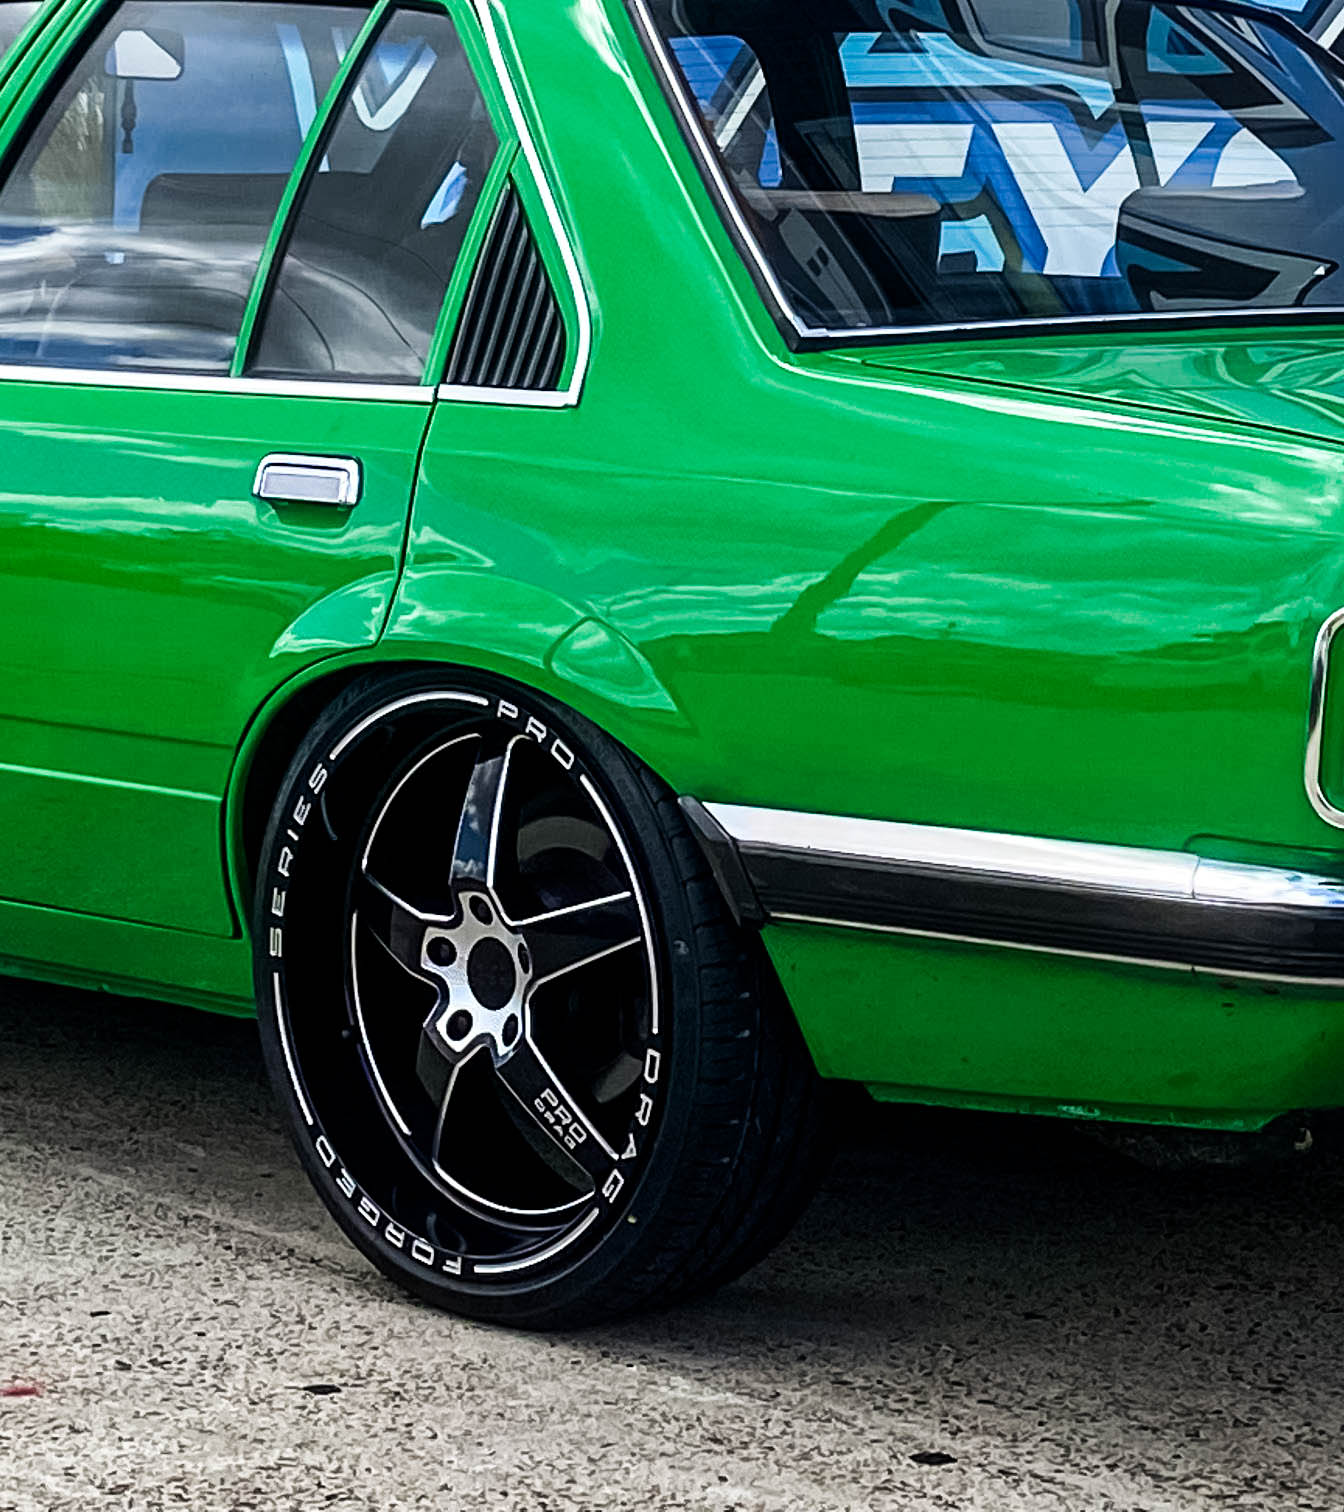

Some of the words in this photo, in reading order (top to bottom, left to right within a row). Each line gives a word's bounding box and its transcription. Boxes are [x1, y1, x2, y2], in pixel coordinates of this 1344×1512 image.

[497, 699, 575, 771] PRO
[268, 762, 331, 959] SERIES
[540, 1088, 588, 1144] PRO
[601, 1048, 660, 1205] DRAG
[315, 1133, 464, 1276] FORGED
